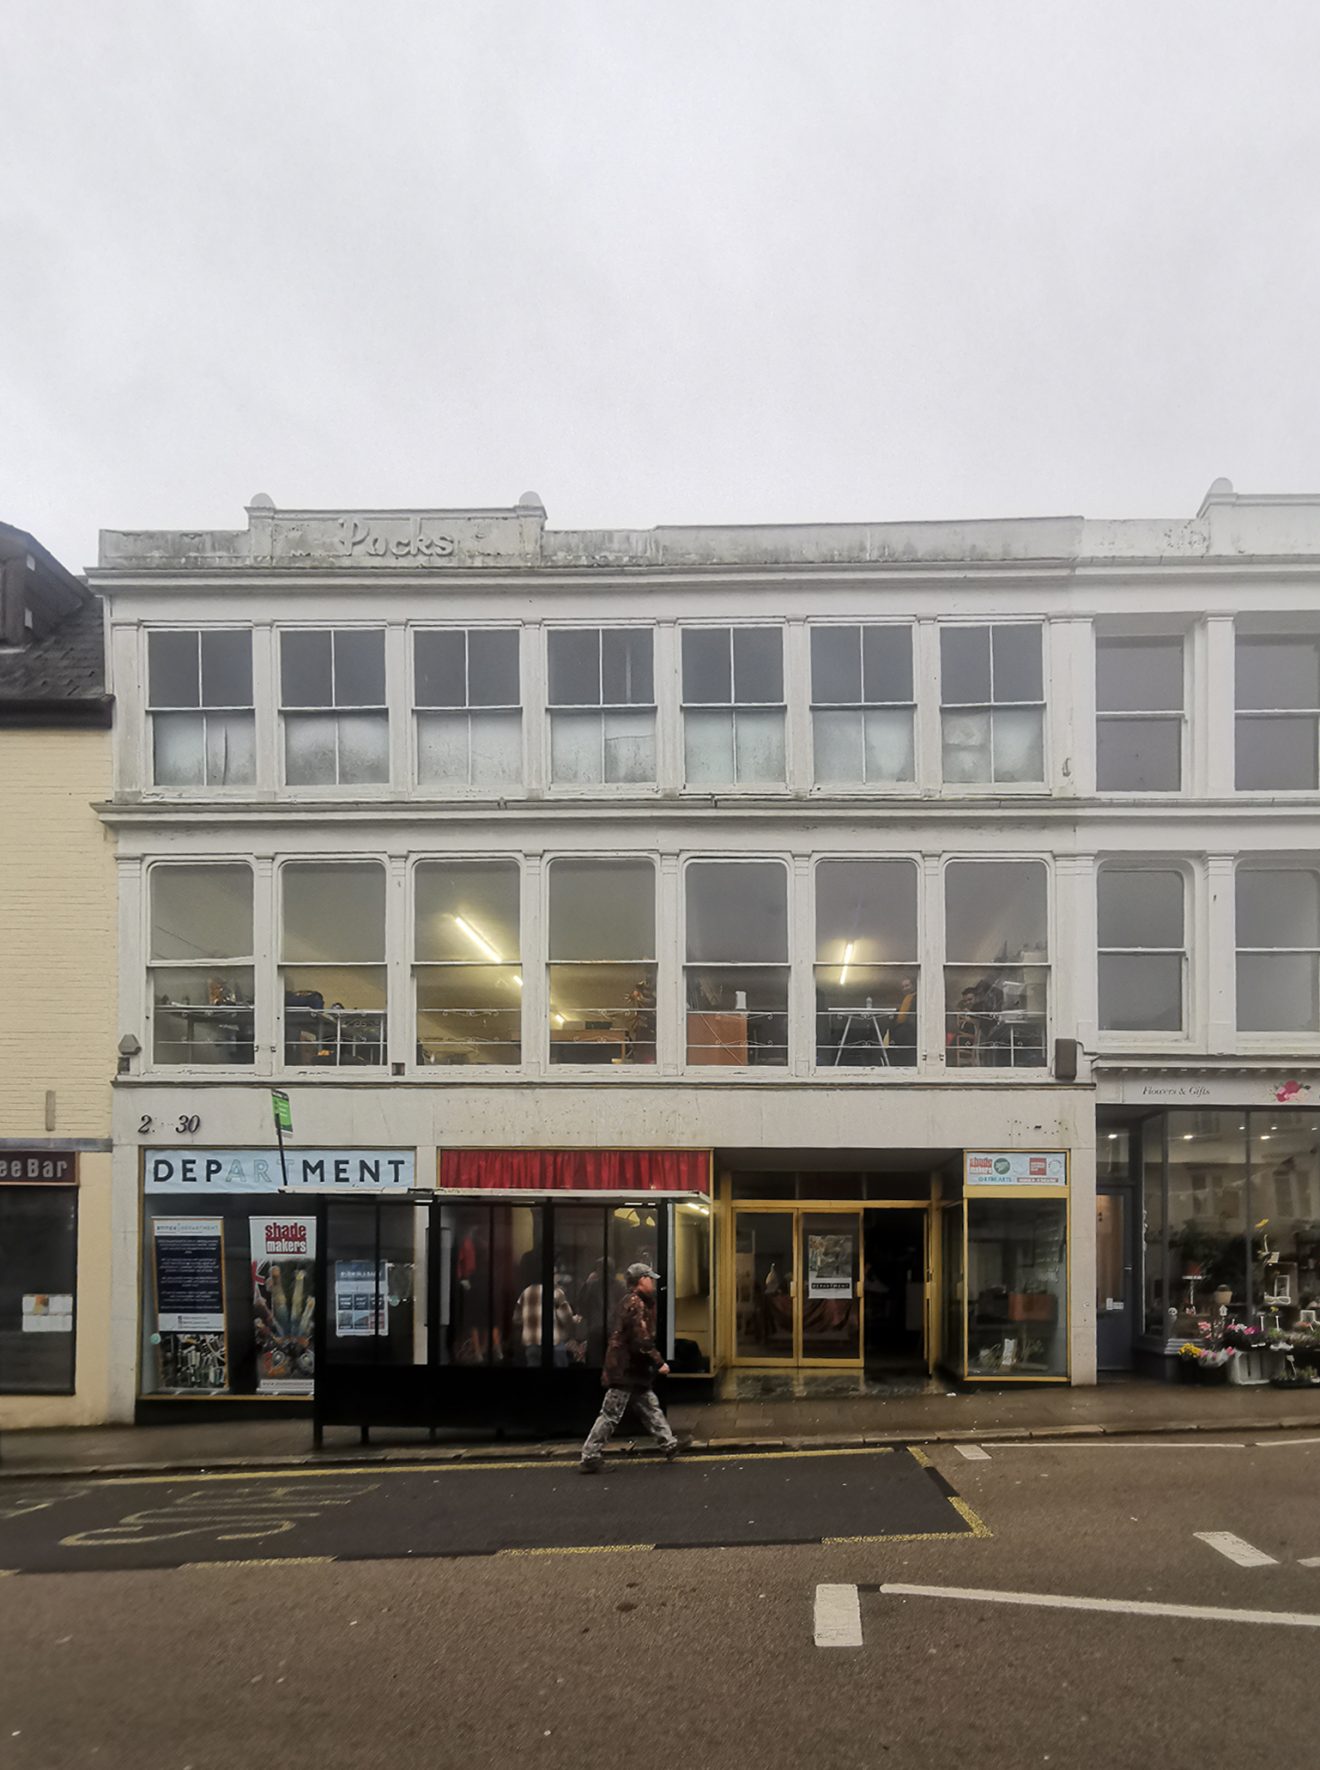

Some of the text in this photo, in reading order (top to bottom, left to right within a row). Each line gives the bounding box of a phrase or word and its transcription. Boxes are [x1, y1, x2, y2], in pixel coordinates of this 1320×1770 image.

[1142, 1086, 1210, 1097] Flowers & Gifts
[138, 1114, 200, 1134] 2 30
[27, 1159, 67, 1178] Bar
[153, 1159, 405, 1183] DEPARTMENT
[265, 1222, 306, 1237] shade
[266, 1238, 306, 1253] makers
